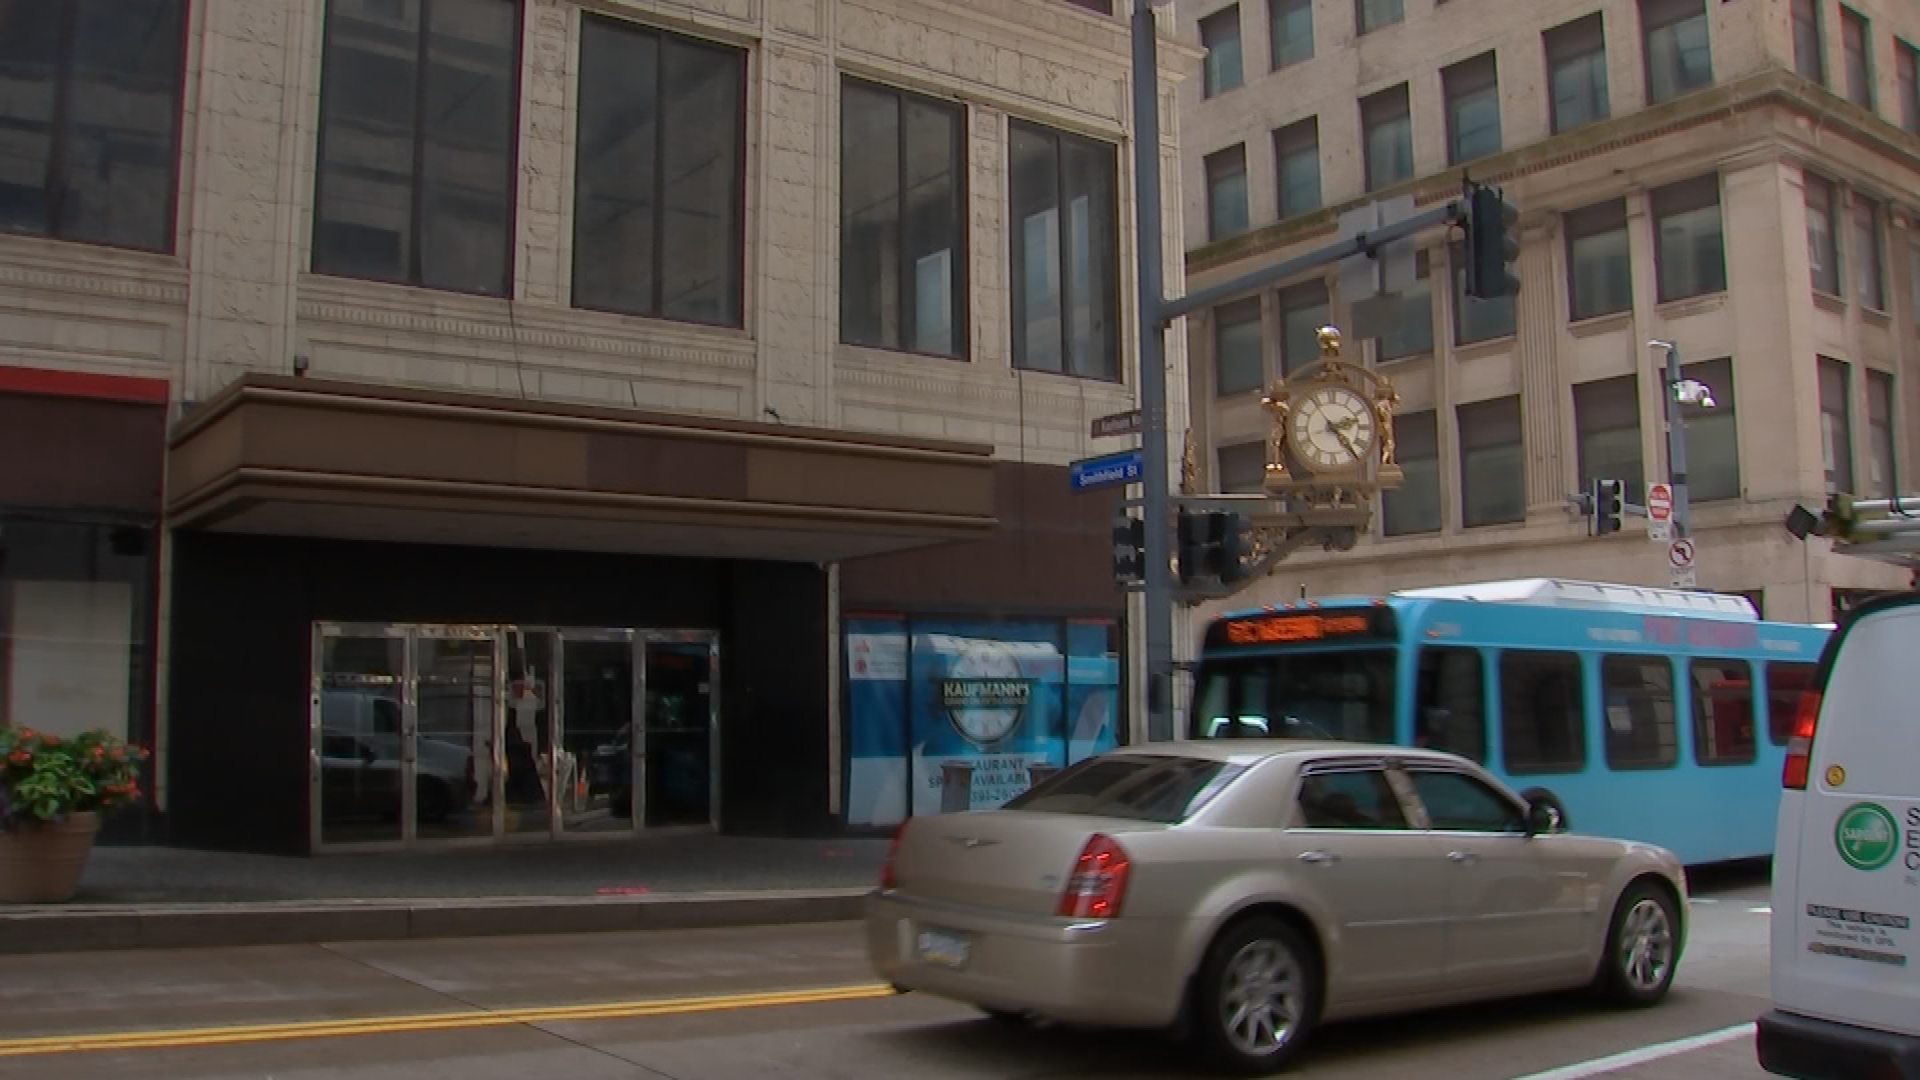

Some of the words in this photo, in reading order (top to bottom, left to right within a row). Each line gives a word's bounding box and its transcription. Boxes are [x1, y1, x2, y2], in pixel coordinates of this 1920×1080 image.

[1127, 465, 1137, 477] St
[943, 682, 1029, 698] KAUFMANN'S
[974, 758, 1025, 771] AURANT
[973, 774, 1027, 787] AVAILABL
